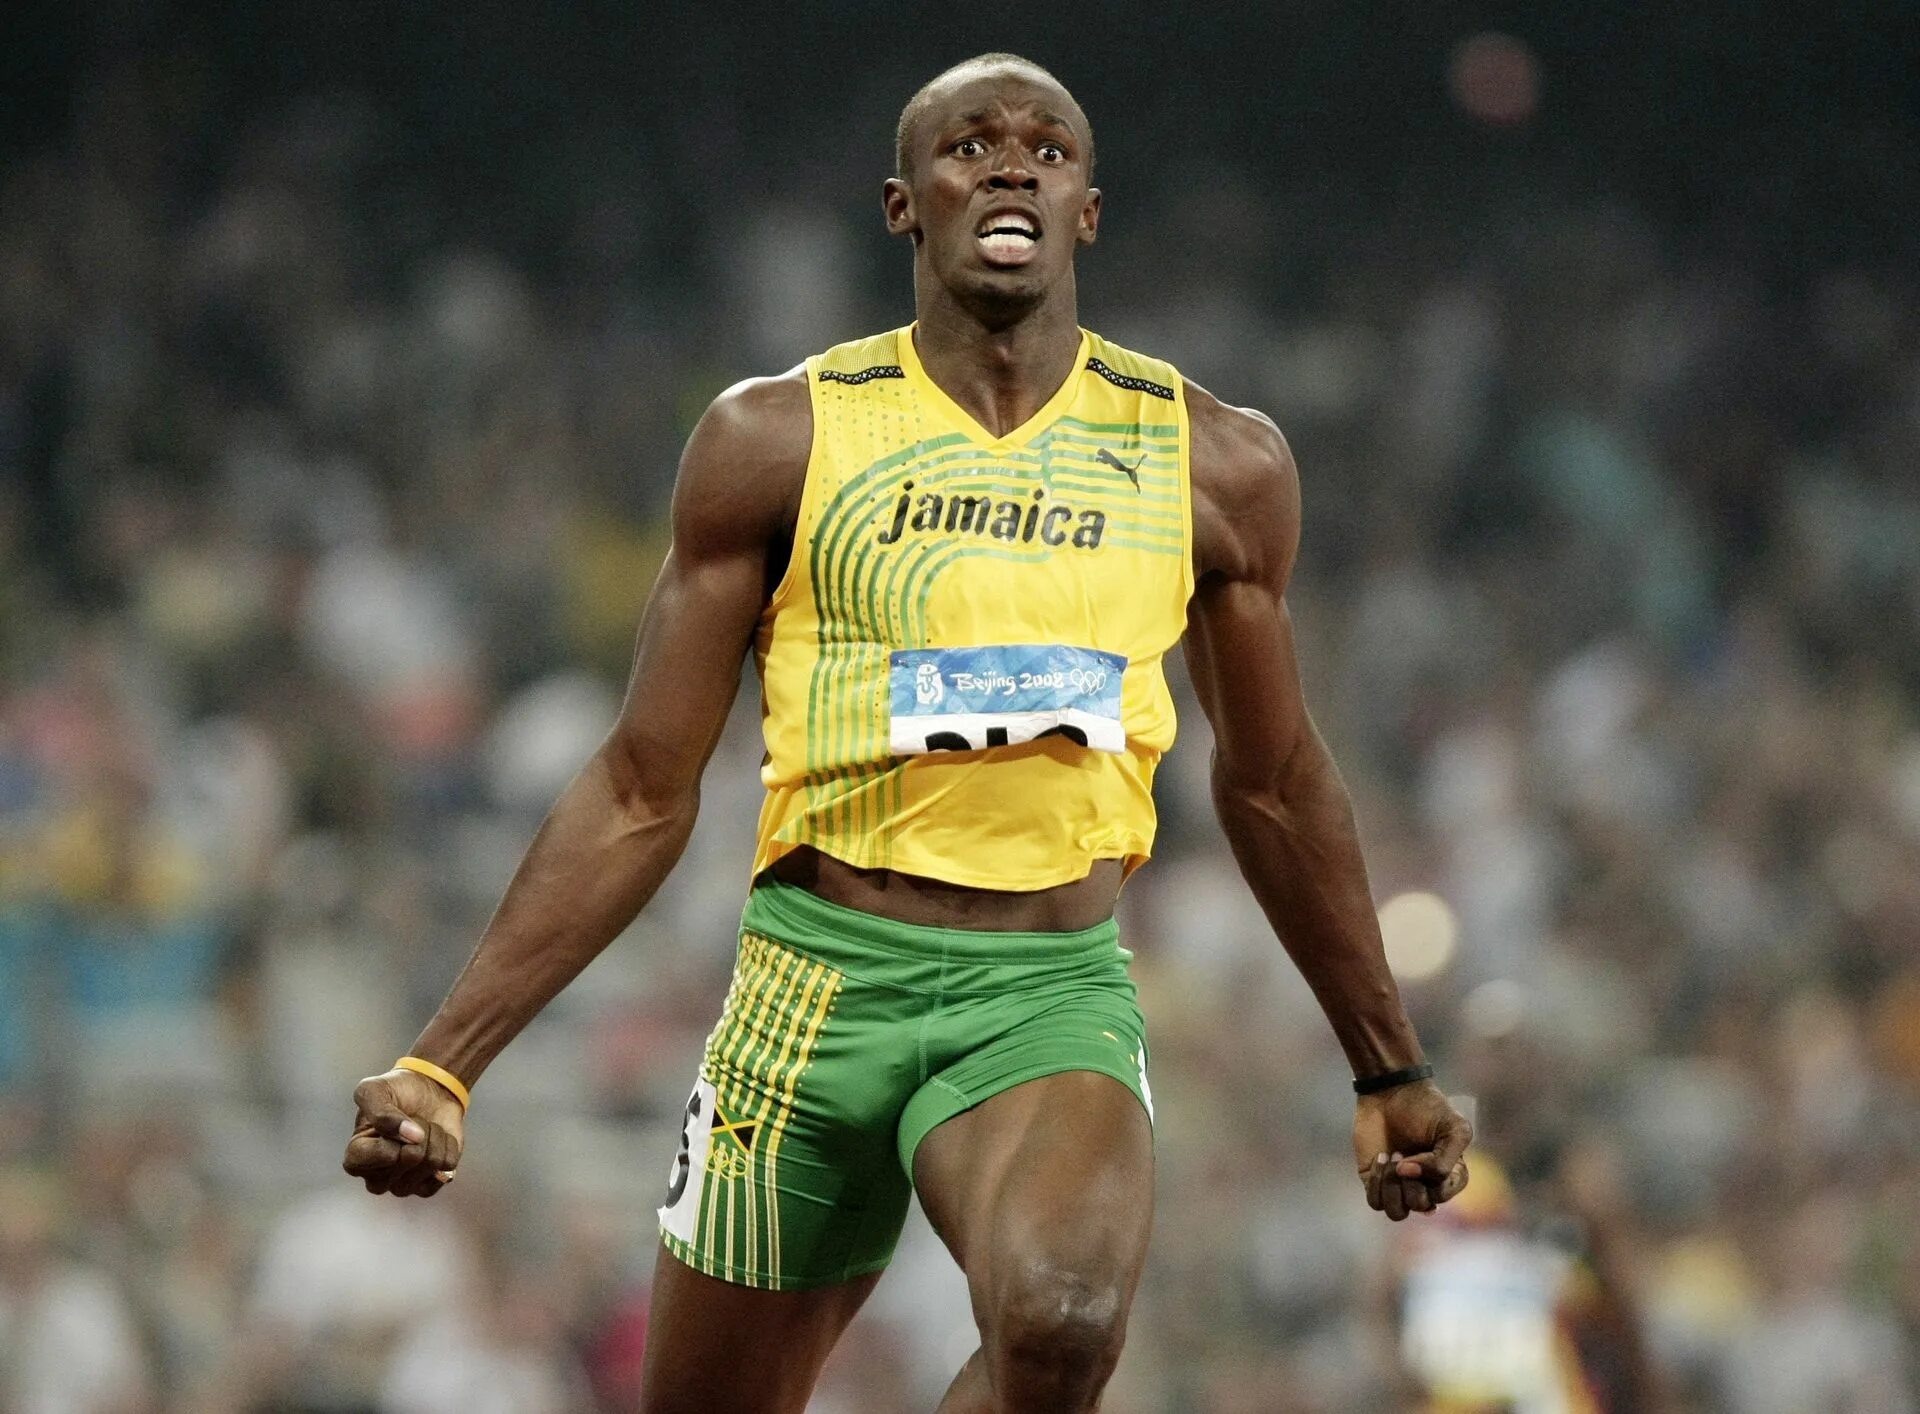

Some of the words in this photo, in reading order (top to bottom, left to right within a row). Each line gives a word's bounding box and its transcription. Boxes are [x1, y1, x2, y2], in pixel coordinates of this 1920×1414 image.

[878, 480, 1106, 549] jamaica
[950, 671, 1016, 696] Beijing
[1019, 671, 1064, 689] 2008
